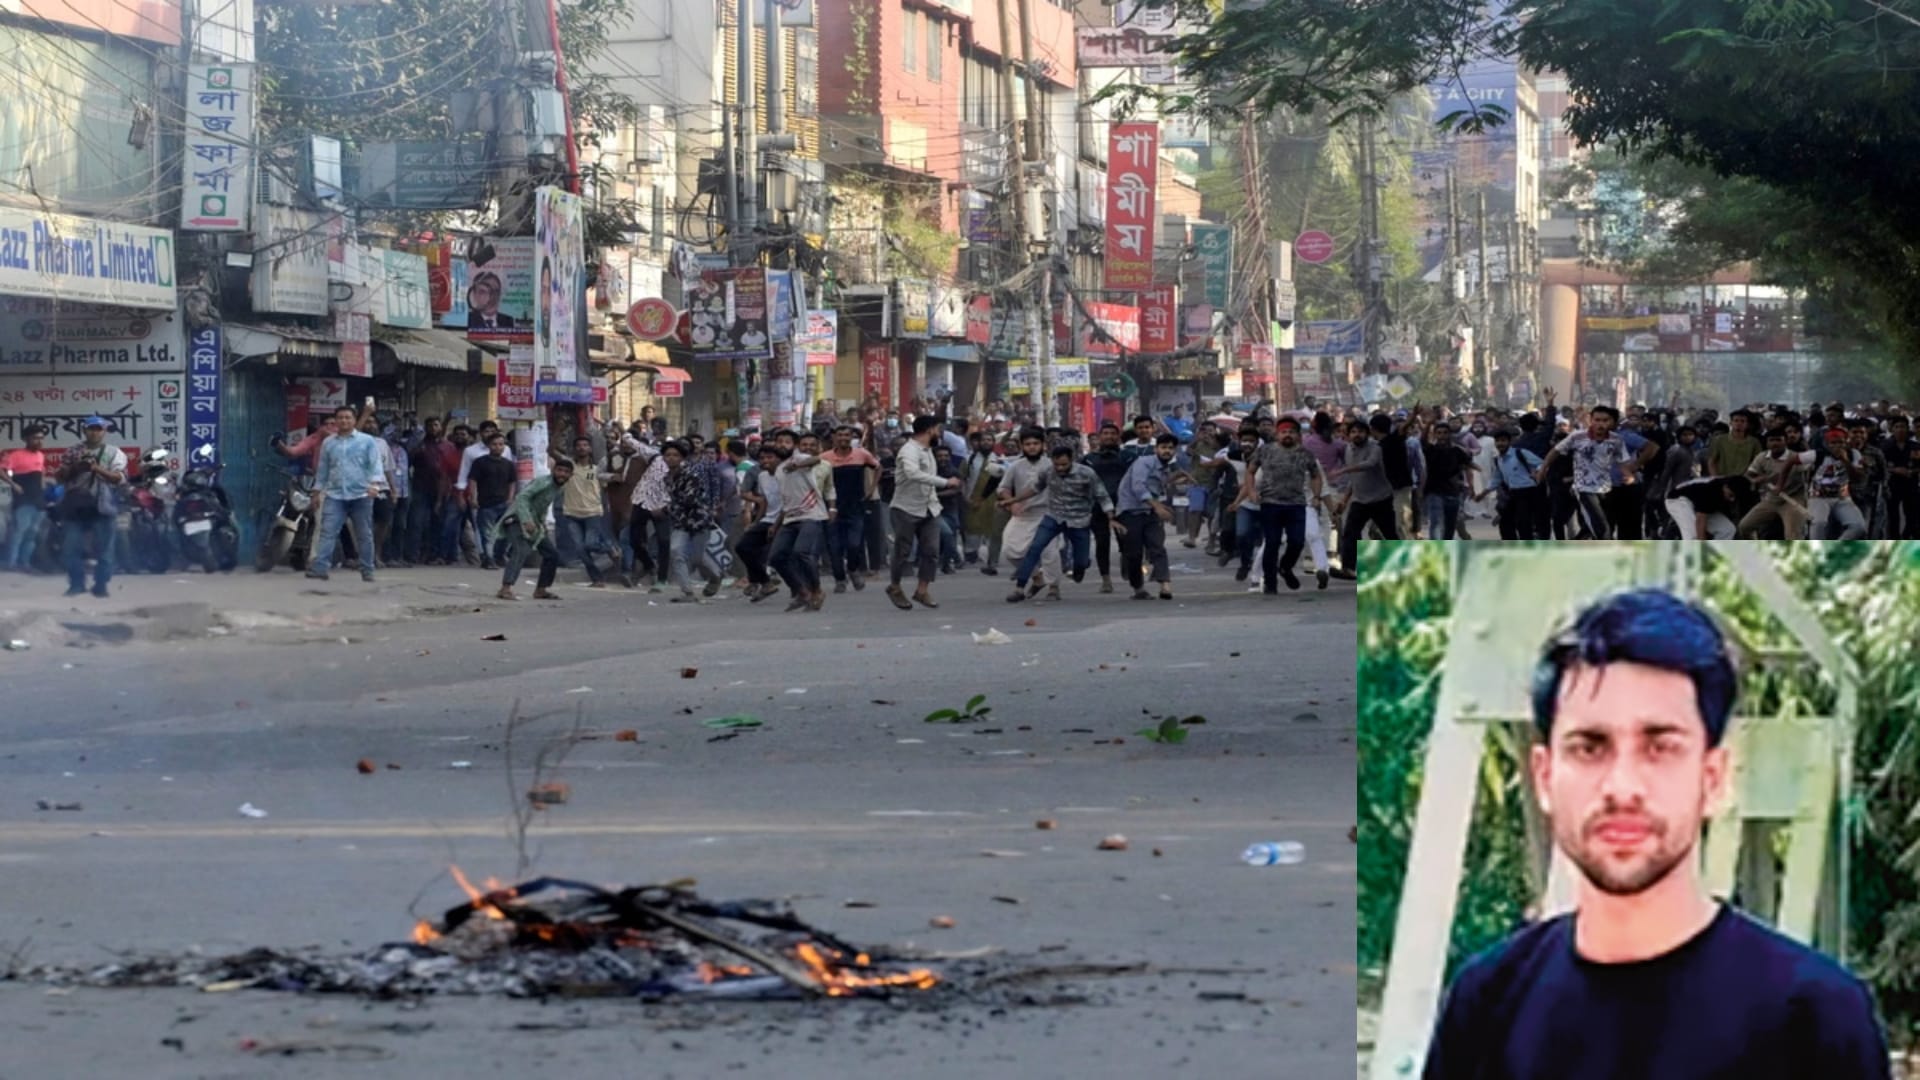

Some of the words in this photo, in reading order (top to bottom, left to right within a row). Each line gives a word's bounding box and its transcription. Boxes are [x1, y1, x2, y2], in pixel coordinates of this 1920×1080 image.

[1447, 88, 1460, 100] A
[1467, 88, 1505, 100] CITY
[1112, 130, 1153, 256] শামীম
[0, 227, 29, 270] azz
[33, 219, 95, 278] Pharma
[98, 227, 157, 285] Limited
[52, 343, 129, 364] Pharma
[136, 343, 175, 363] Ltd.
